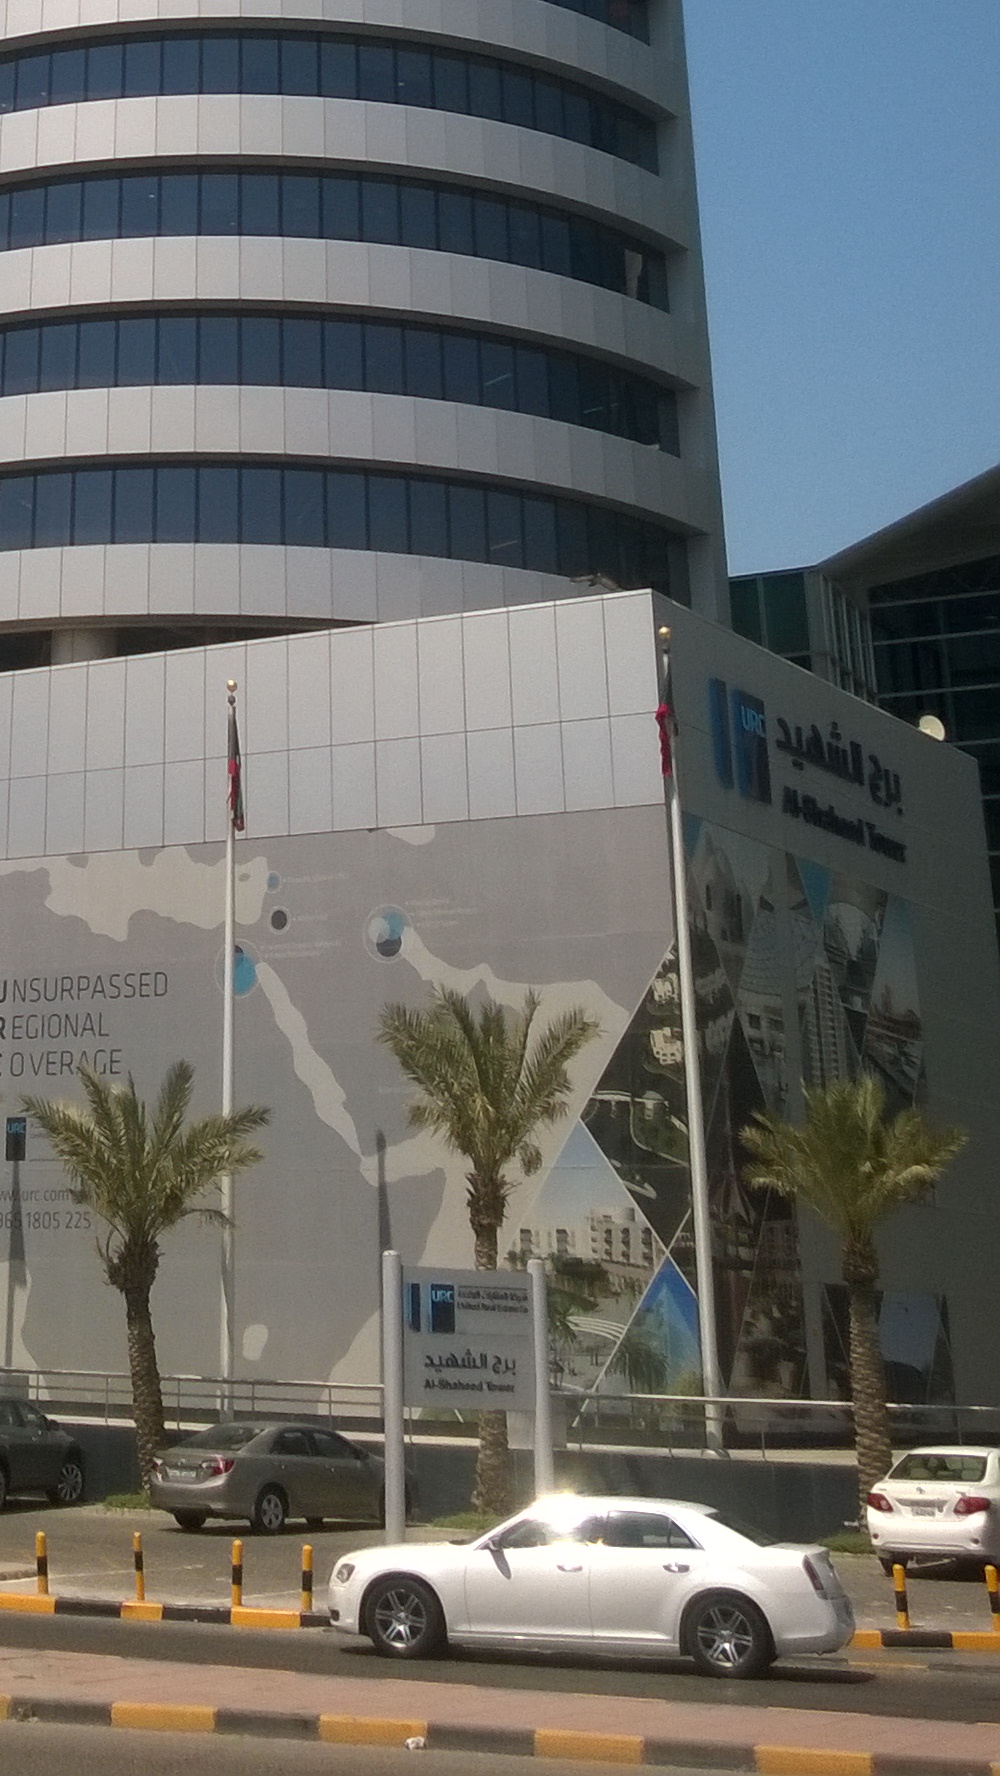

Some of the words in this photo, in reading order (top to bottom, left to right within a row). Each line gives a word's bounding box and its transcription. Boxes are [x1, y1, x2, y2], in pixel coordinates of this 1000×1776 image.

[27, 1211, 61, 1230] 1805
[64, 1211, 92, 1230] 225
[431, 1289, 455, 1303] URC
[424, 1348, 487, 1373] الشهيد
[492, 1355, 516, 1376] برج
